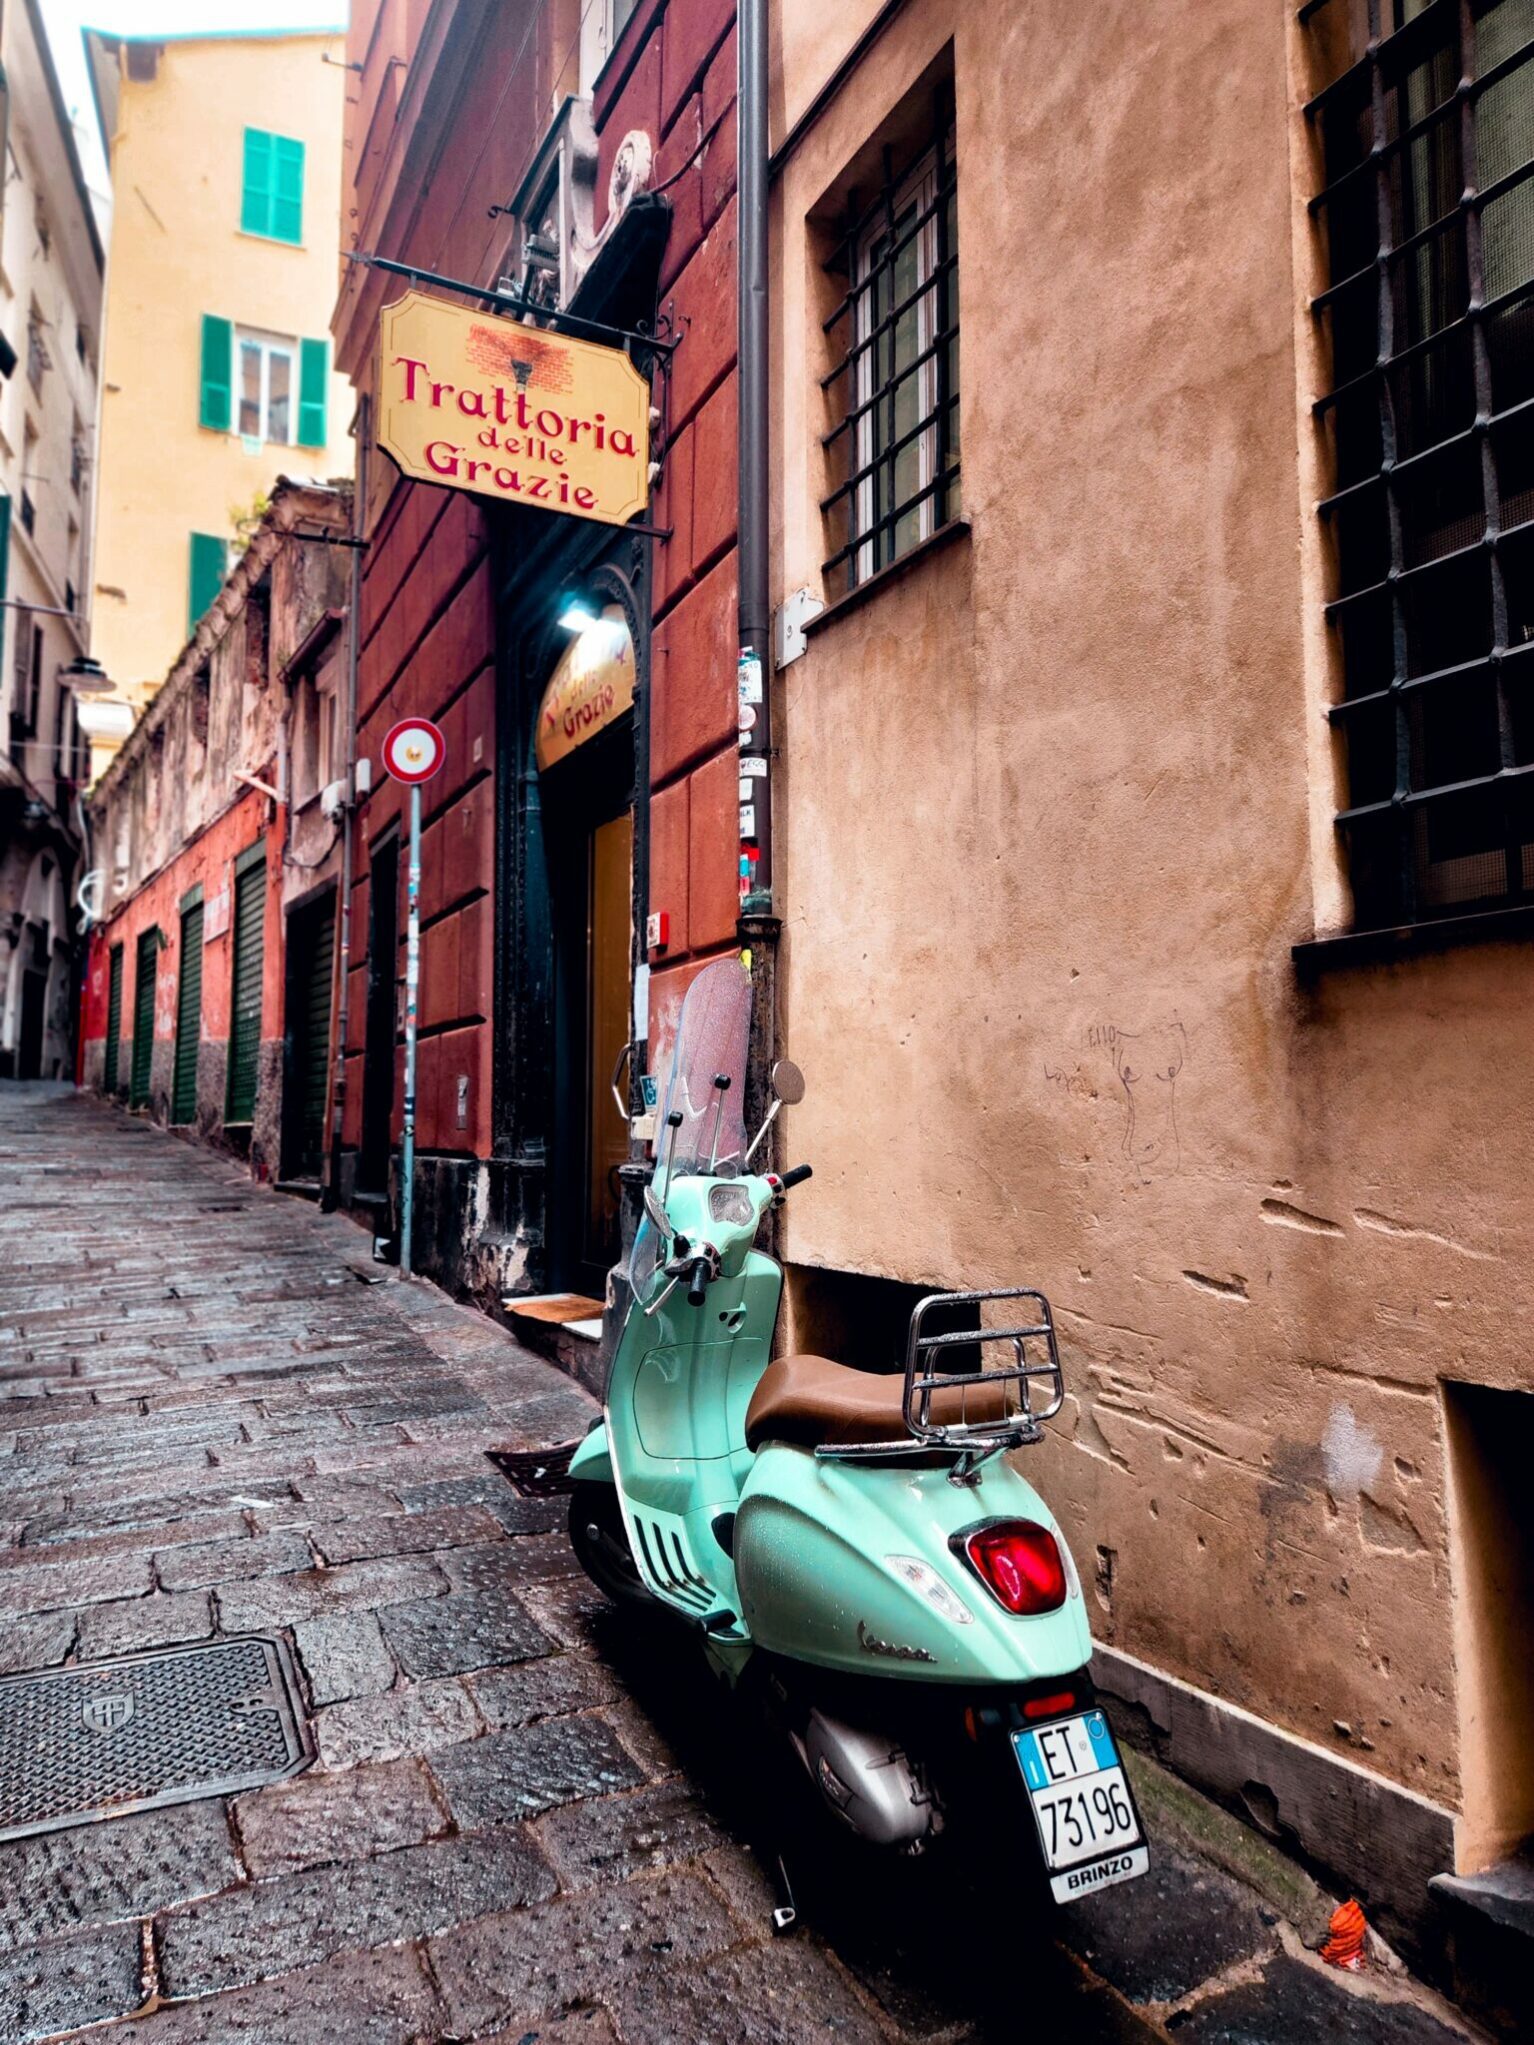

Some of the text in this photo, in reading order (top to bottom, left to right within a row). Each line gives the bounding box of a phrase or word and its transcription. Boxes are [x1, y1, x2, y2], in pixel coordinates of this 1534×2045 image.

[391, 356, 640, 458] Trattoria
[477, 426, 568, 466] delle
[424, 441, 599, 510] Grazie
[563, 684, 614, 739] Grazie
[1038, 1725, 1078, 1781] ET
[1040, 1782, 1132, 1856] 73196
[1067, 1855, 1134, 1890] BRINZO
